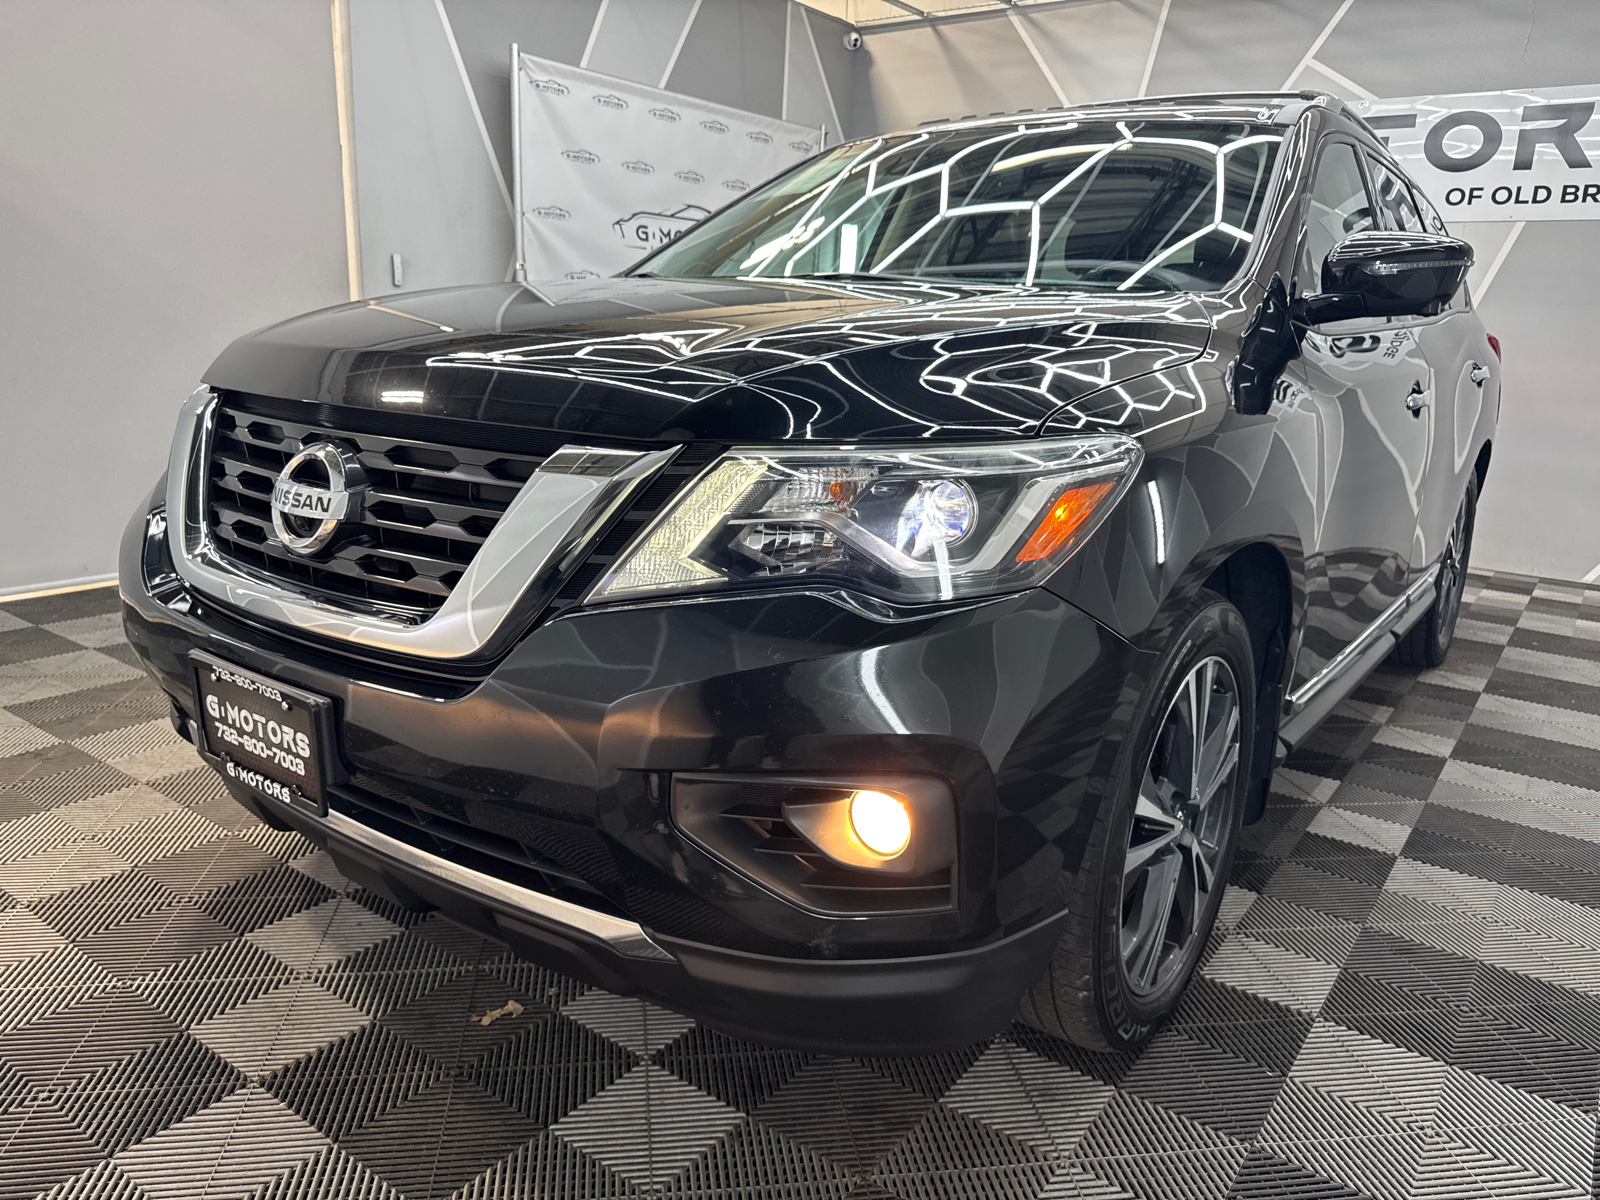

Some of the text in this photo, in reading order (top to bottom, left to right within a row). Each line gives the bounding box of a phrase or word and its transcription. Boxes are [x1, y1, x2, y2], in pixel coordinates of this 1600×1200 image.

[1445, 187, 1484, 206] OF
[1491, 185, 1552, 206] OLD
[274, 485, 332, 513] NISSAN
[212, 665, 282, 701] 732-800-7003
[214, 721, 306, 776] 732-800-7003
